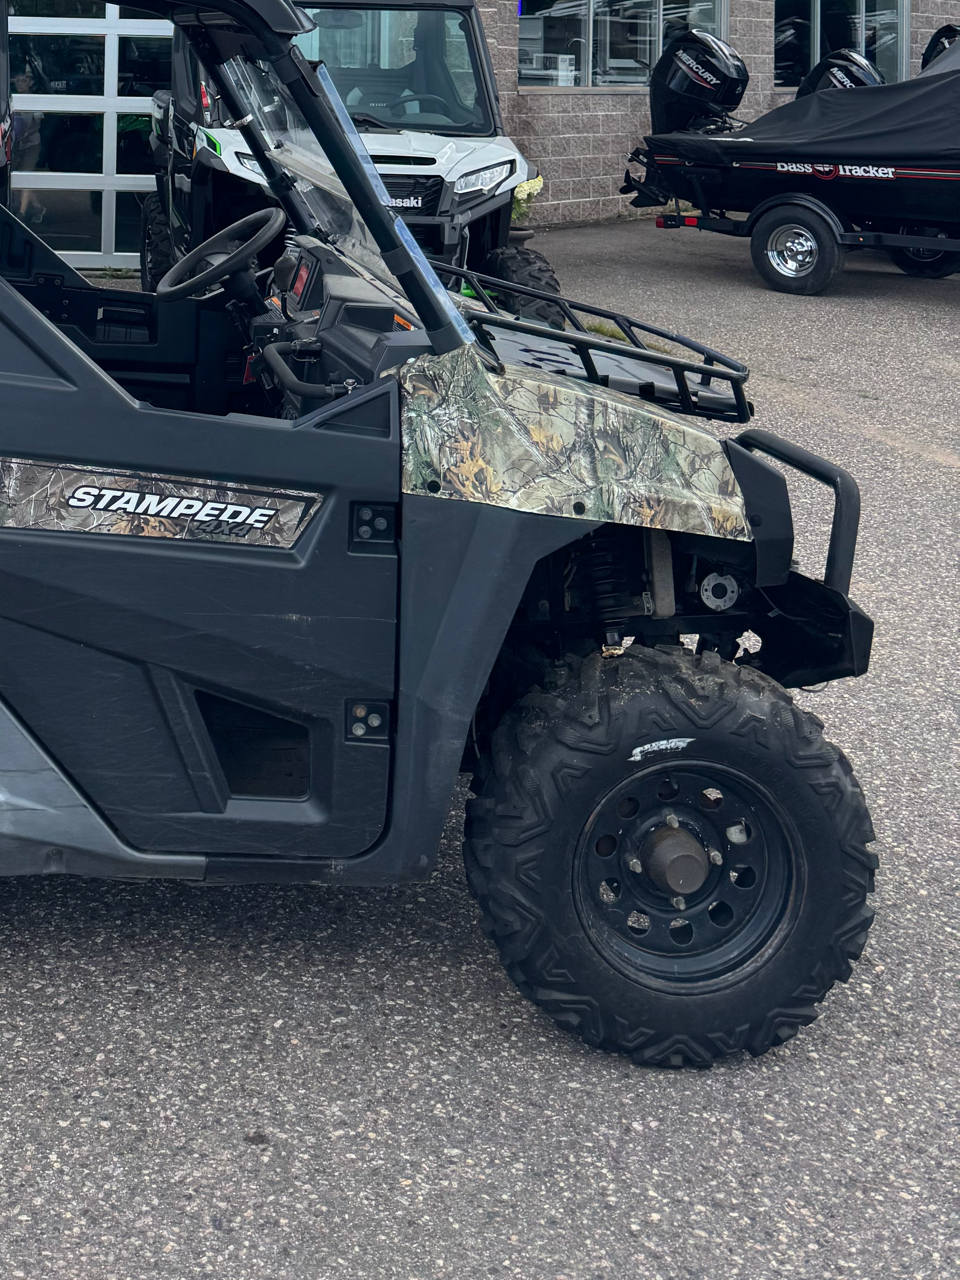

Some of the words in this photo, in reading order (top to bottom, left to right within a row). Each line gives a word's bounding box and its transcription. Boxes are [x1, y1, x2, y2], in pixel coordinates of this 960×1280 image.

[675, 49, 721, 85] MERCURY
[829, 67, 856, 89] MERC
[388, 196, 422, 207] asaki
[68, 486, 277, 528] STAMPEDE
